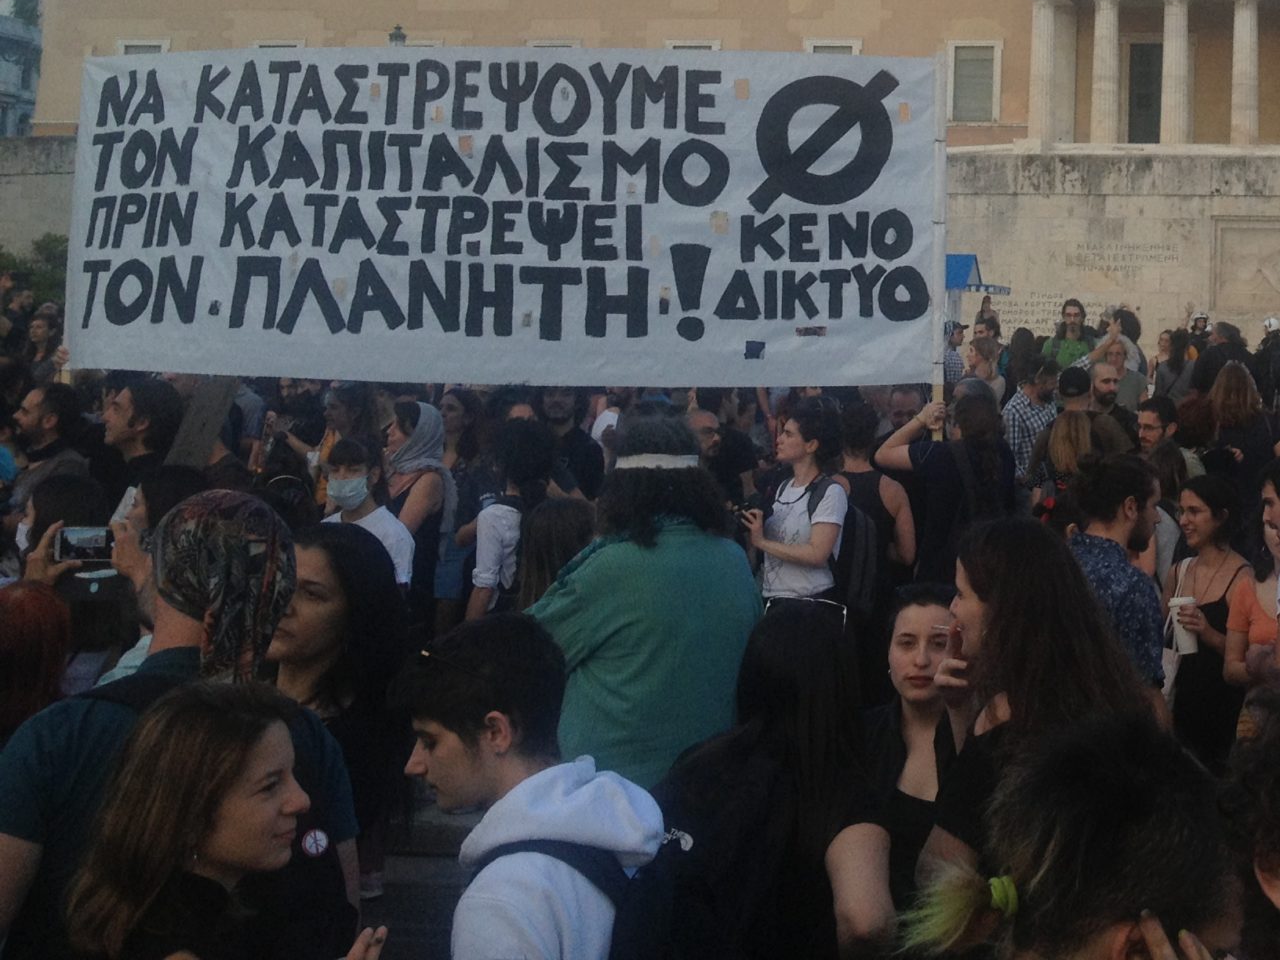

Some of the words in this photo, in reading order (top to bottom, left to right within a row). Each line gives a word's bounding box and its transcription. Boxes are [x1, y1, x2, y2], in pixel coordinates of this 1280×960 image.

[96, 69, 165, 127] ΝΑ
[194, 59, 726, 137] ΚΑΤΑΣΤΡΕΨΟΥΜΕ
[92, 127, 198, 192] ΤΟΝ
[226, 124, 730, 207] ΚΑΠΙΤΑΛΙΣΜΟ
[85, 191, 198, 248] ΠΡΙΝ
[219, 192, 643, 262] ΚΑΤΑΣΤΡΕΨΕΙ
[740, 209, 913, 263] ΚΕΝΟ
[82, 255, 203, 330] ΤΟΝ
[713, 264, 930, 322] ΔΙΚΤΥΟ
